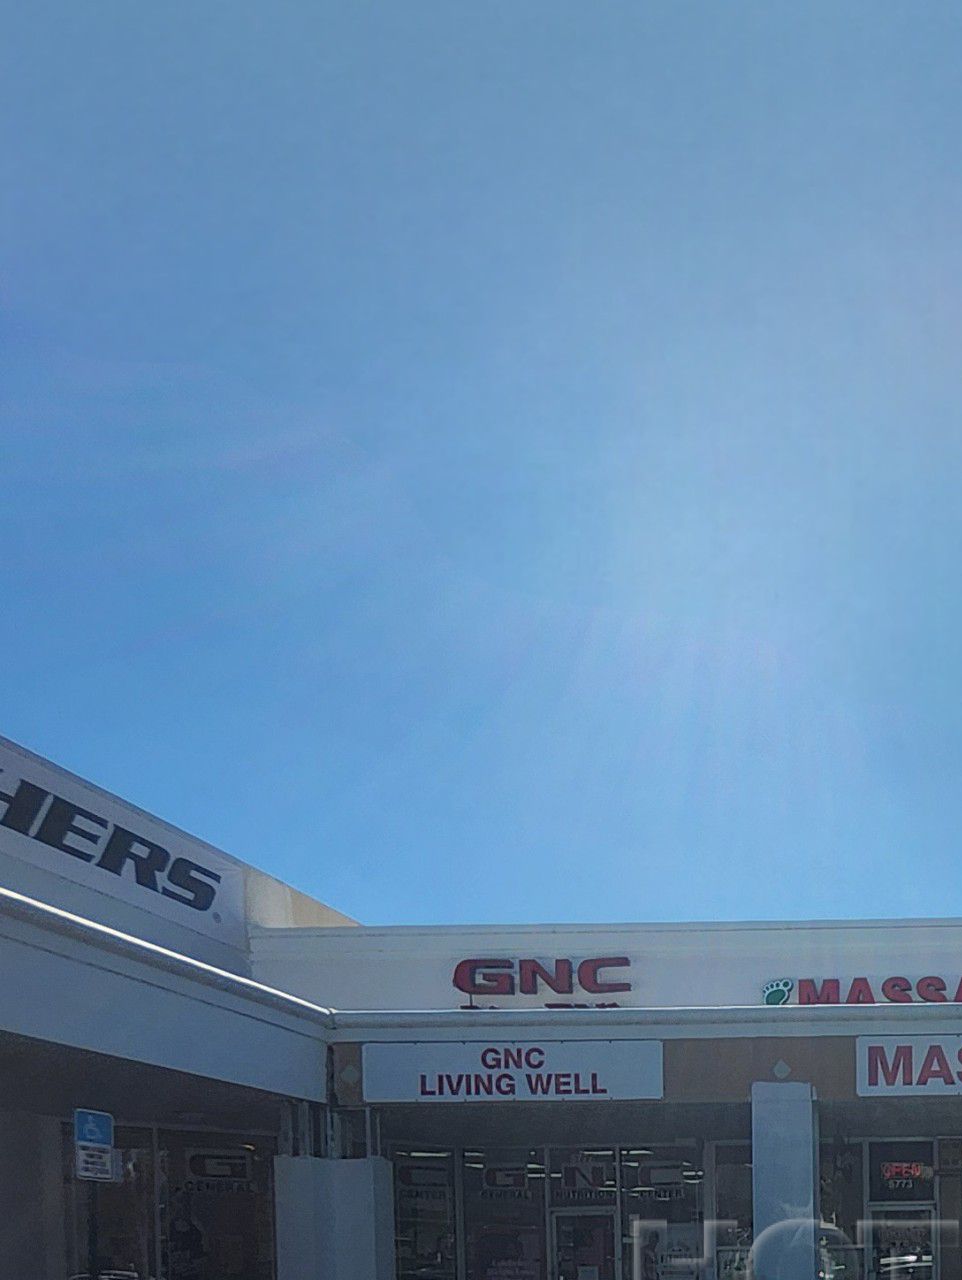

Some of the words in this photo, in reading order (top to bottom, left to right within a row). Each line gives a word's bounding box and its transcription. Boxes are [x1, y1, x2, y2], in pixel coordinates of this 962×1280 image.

[453, 957, 631, 995] GNC
[480, 1047, 545, 1069] GNC
[419, 1073, 516, 1096] LIVING
[525, 1072, 608, 1095] WELL
